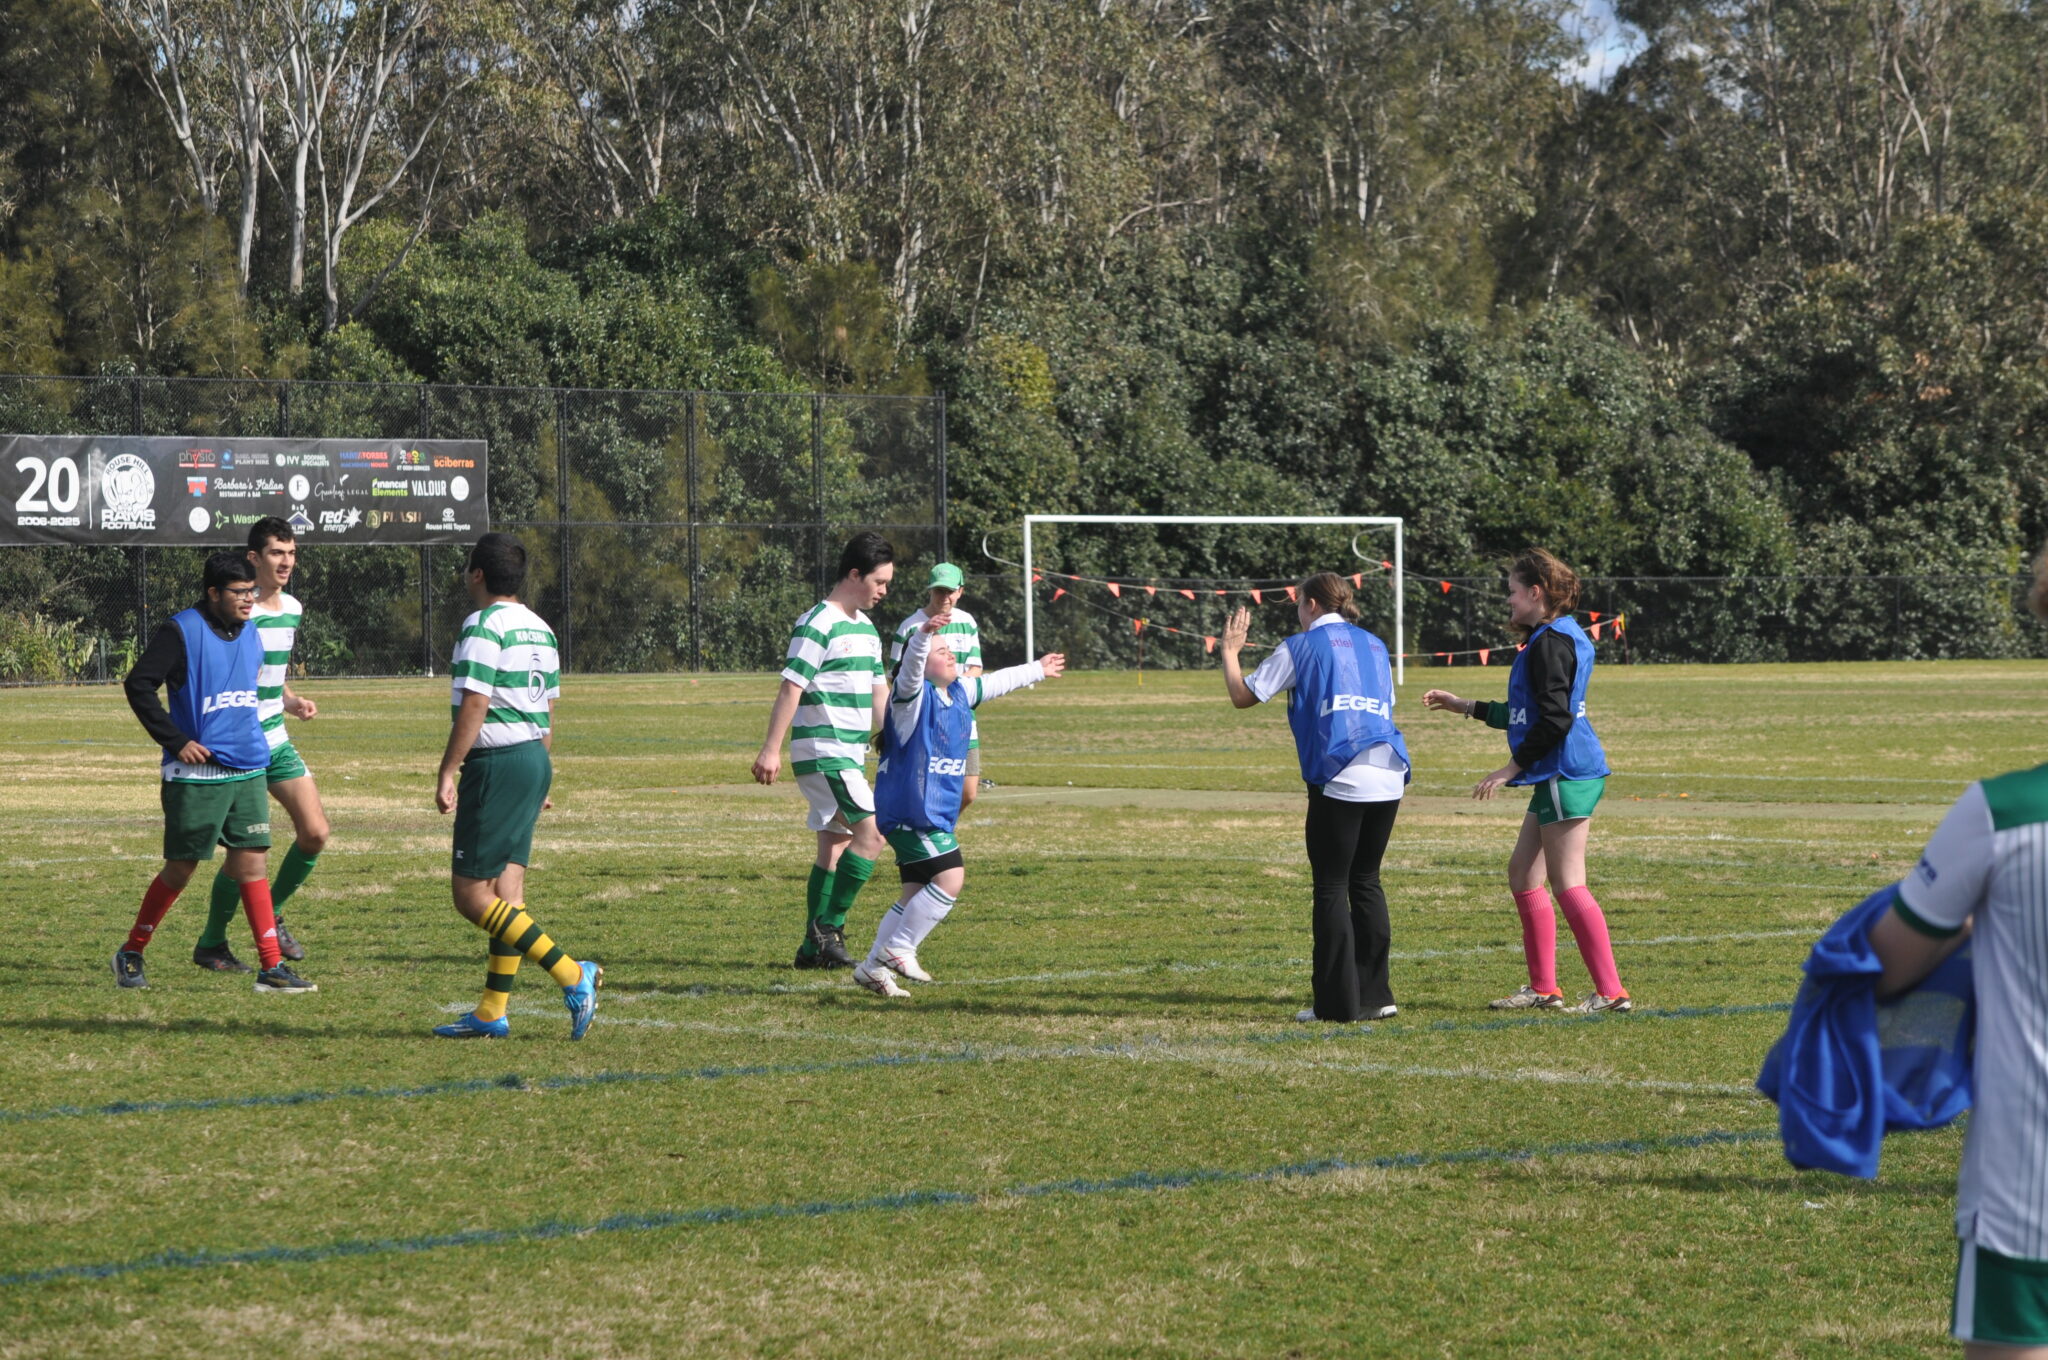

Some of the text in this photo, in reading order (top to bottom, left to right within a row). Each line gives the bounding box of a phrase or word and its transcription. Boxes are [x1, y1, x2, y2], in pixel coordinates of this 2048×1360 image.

[178, 449, 216, 466] physio
[286, 455, 300, 465] IVY
[433, 457, 474, 468] sciberras
[105, 456, 149, 475] ROUSE HILL
[15, 456, 80, 513] 20
[213, 477, 253, 490] Barbara's
[255, 479, 284, 490] Italian
[372, 478, 408, 489] Financial
[411, 480, 447, 496] VALOUR
[372, 488, 409, 497] Elements
[101, 508, 156, 522] RAMS
[318, 508, 346, 524] red
[101, 521, 156, 530] FOOTBALL
[323, 523, 348, 534] energy
[425, 522, 471, 532] Rouse Hill Toyota
[528, 653, 546, 703] 6
[202, 690, 258, 715] LEGE
[1320, 694, 1390, 721] LEGEA
